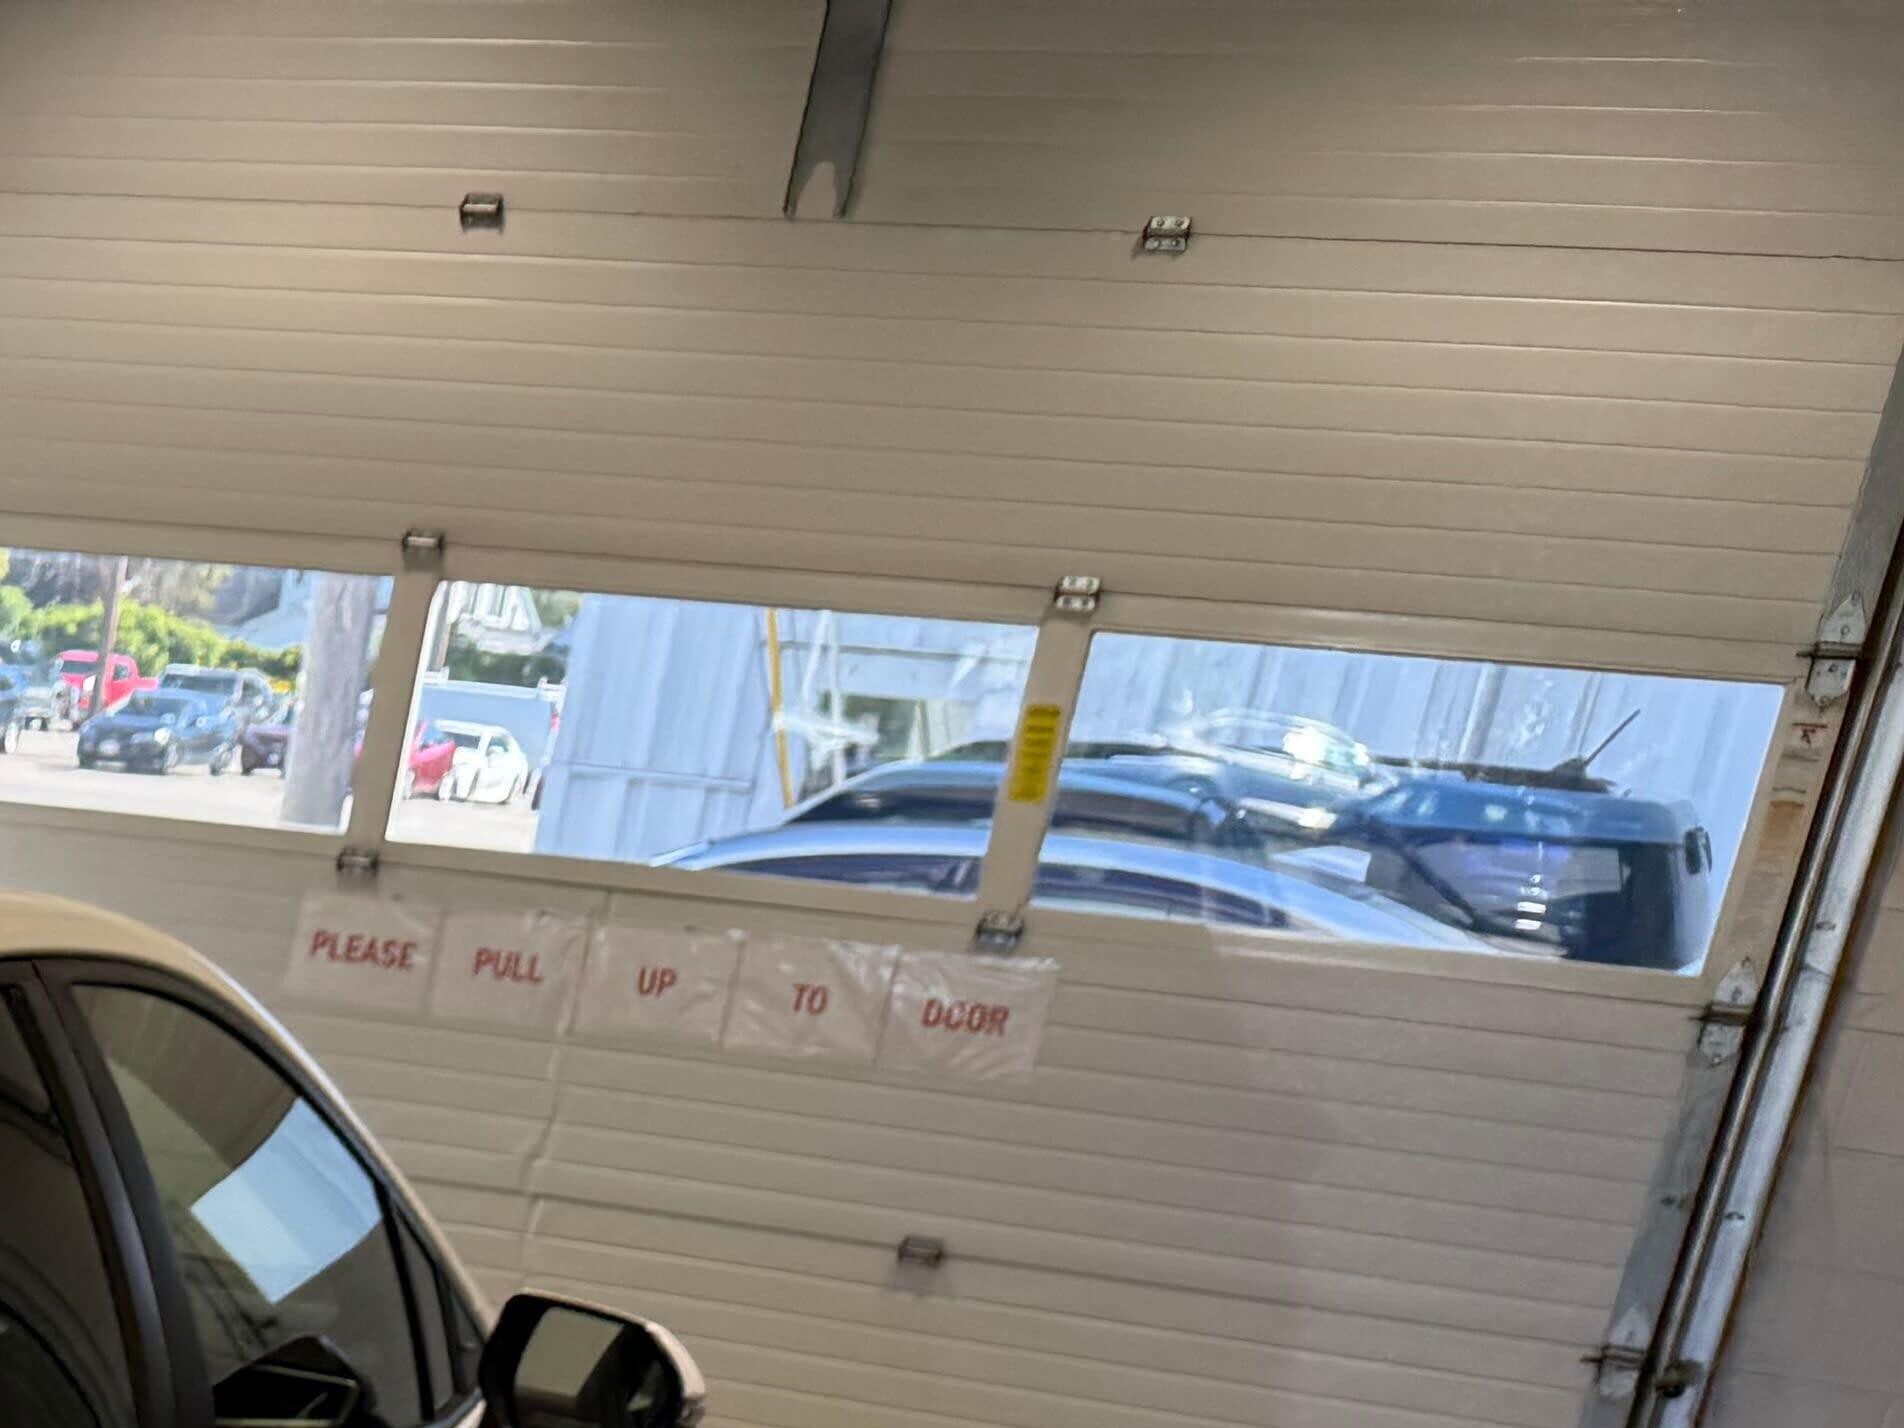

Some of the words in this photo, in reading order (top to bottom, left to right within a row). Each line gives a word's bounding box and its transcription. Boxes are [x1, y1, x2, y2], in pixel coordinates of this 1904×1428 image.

[310, 929, 415, 971] PLEASE
[472, 947, 543, 984] PULL
[636, 965, 677, 998] UP
[794, 983, 828, 1016] TO
[921, 998, 1010, 1037] DOOR
